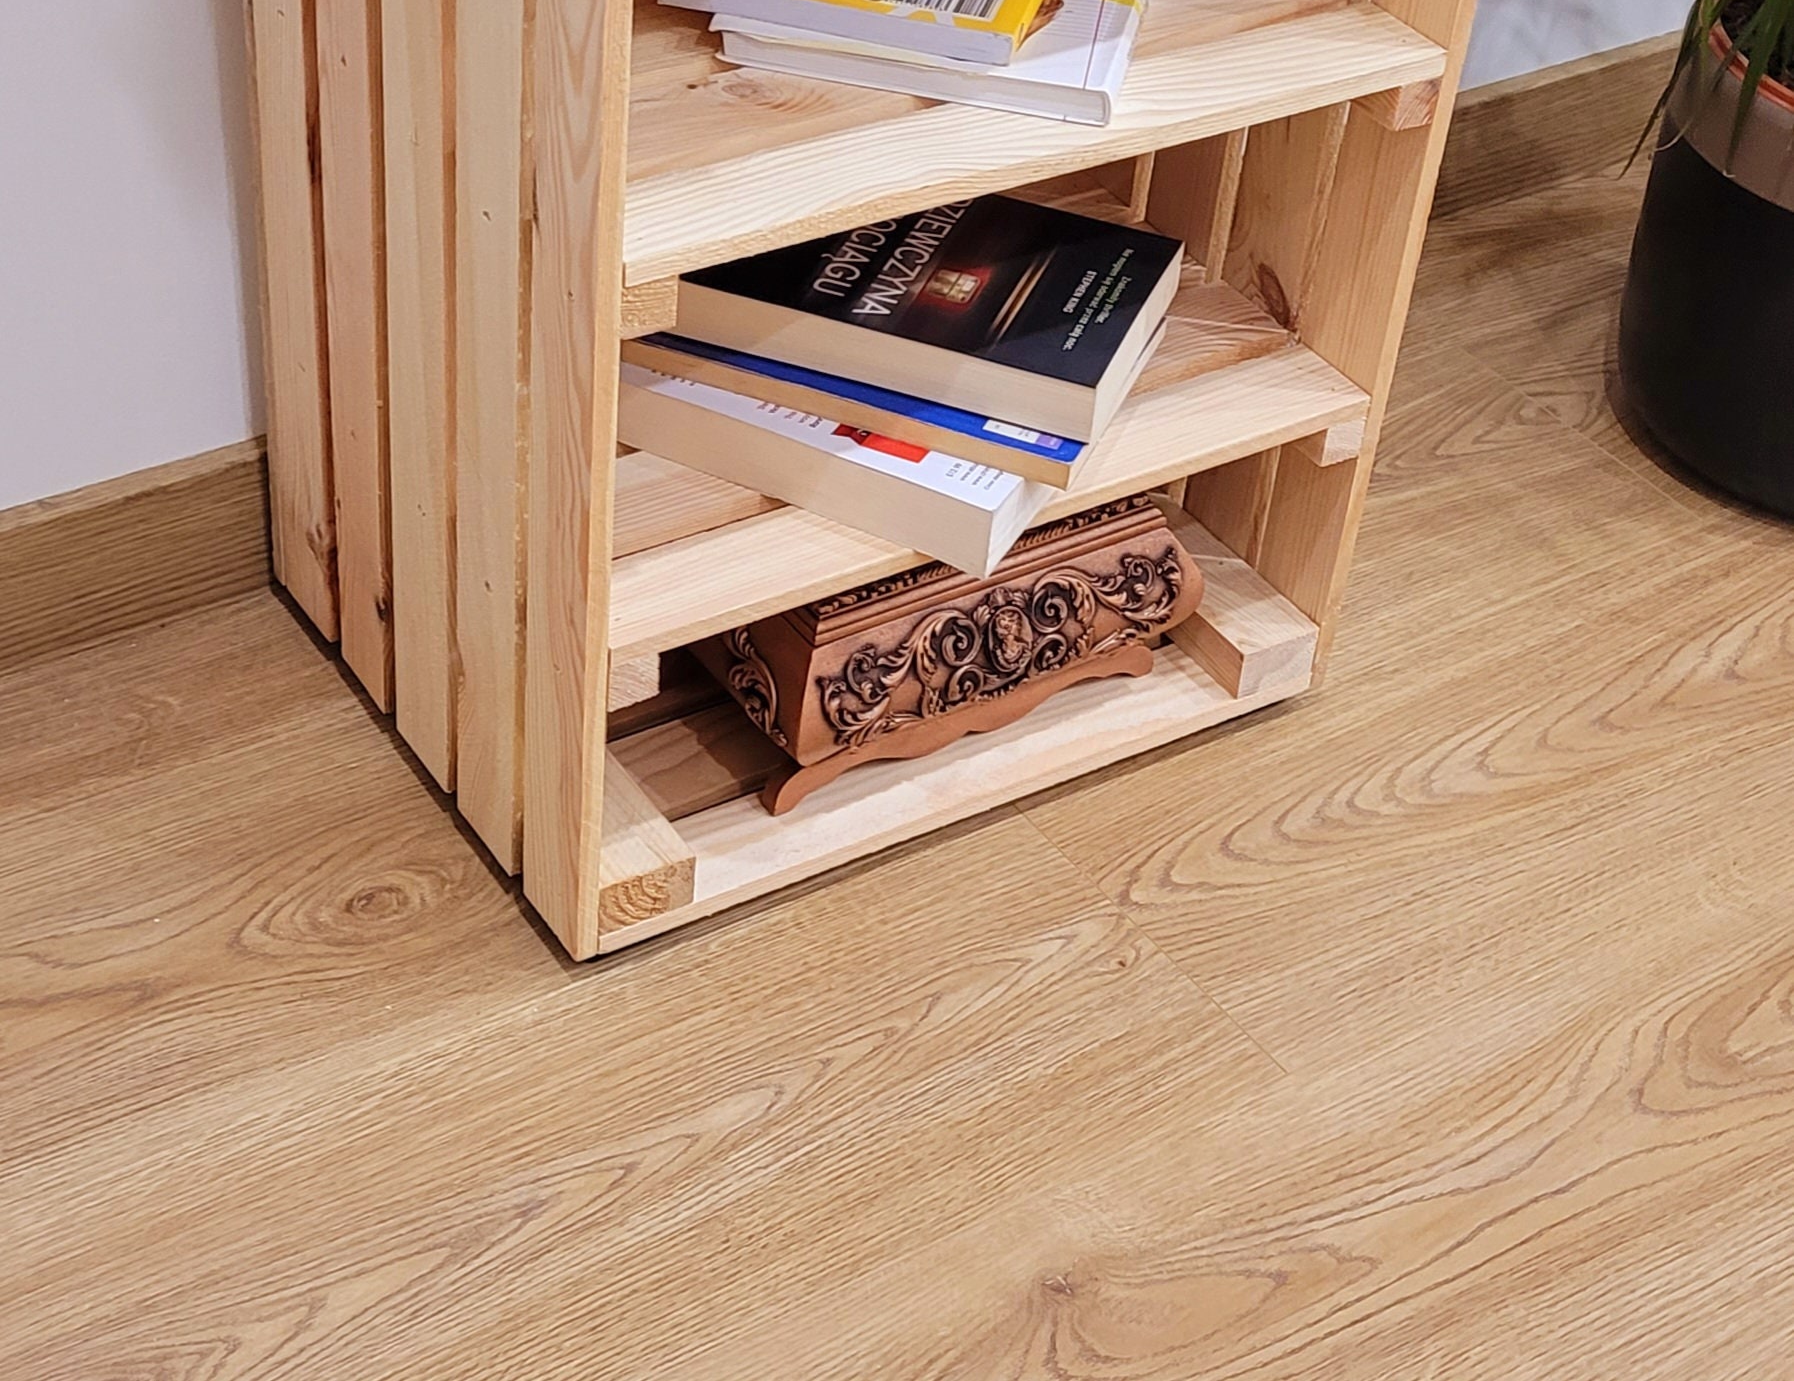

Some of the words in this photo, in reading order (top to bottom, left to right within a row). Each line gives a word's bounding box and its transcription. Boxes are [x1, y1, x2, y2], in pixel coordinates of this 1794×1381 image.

[813, 220, 897, 297] OCIĄGU
[1072, 270, 1098, 297] STEPHEN
[1062, 297, 1080, 314] KING
